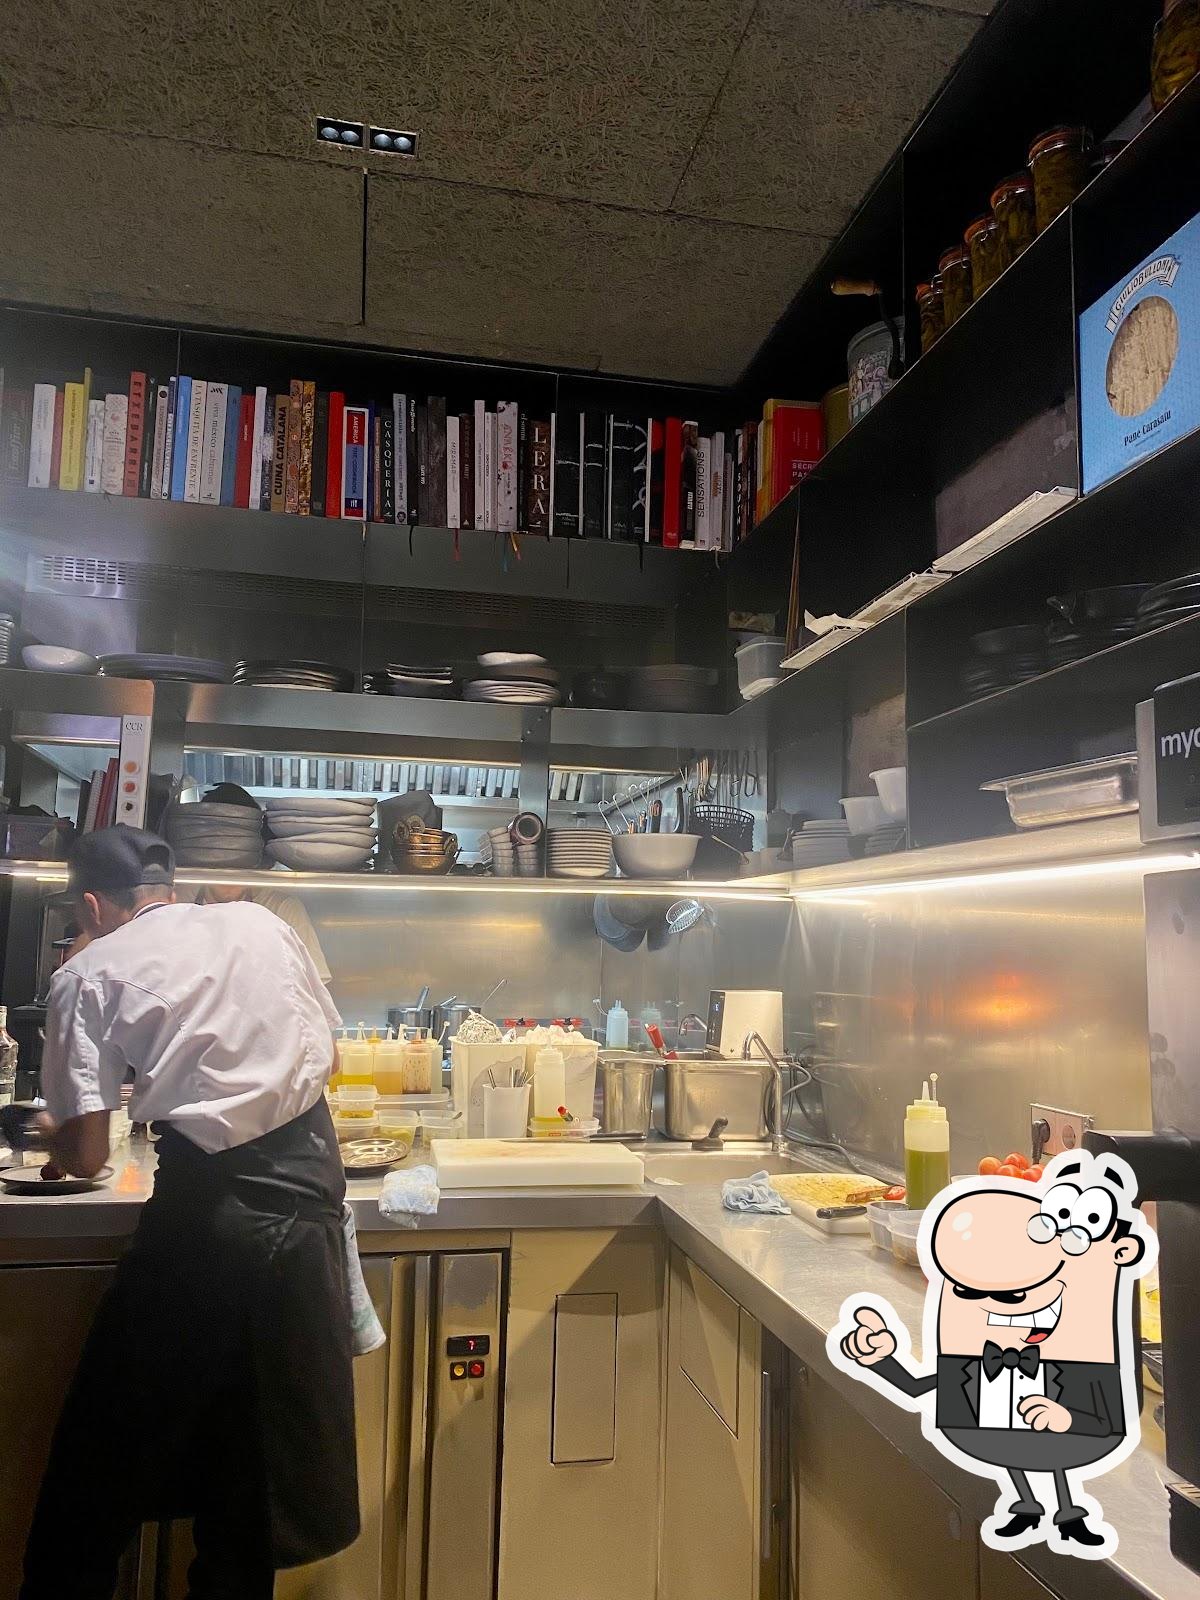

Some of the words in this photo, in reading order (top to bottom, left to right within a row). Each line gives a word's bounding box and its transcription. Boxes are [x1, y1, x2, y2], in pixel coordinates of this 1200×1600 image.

[276, 406, 287, 460] CATALANA
[1124, 430, 1141, 447] Pane
[274, 462, 284, 496] CUINA
[532, 427, 548, 515] LERA
[697, 450, 705, 518] SENSATIONS
